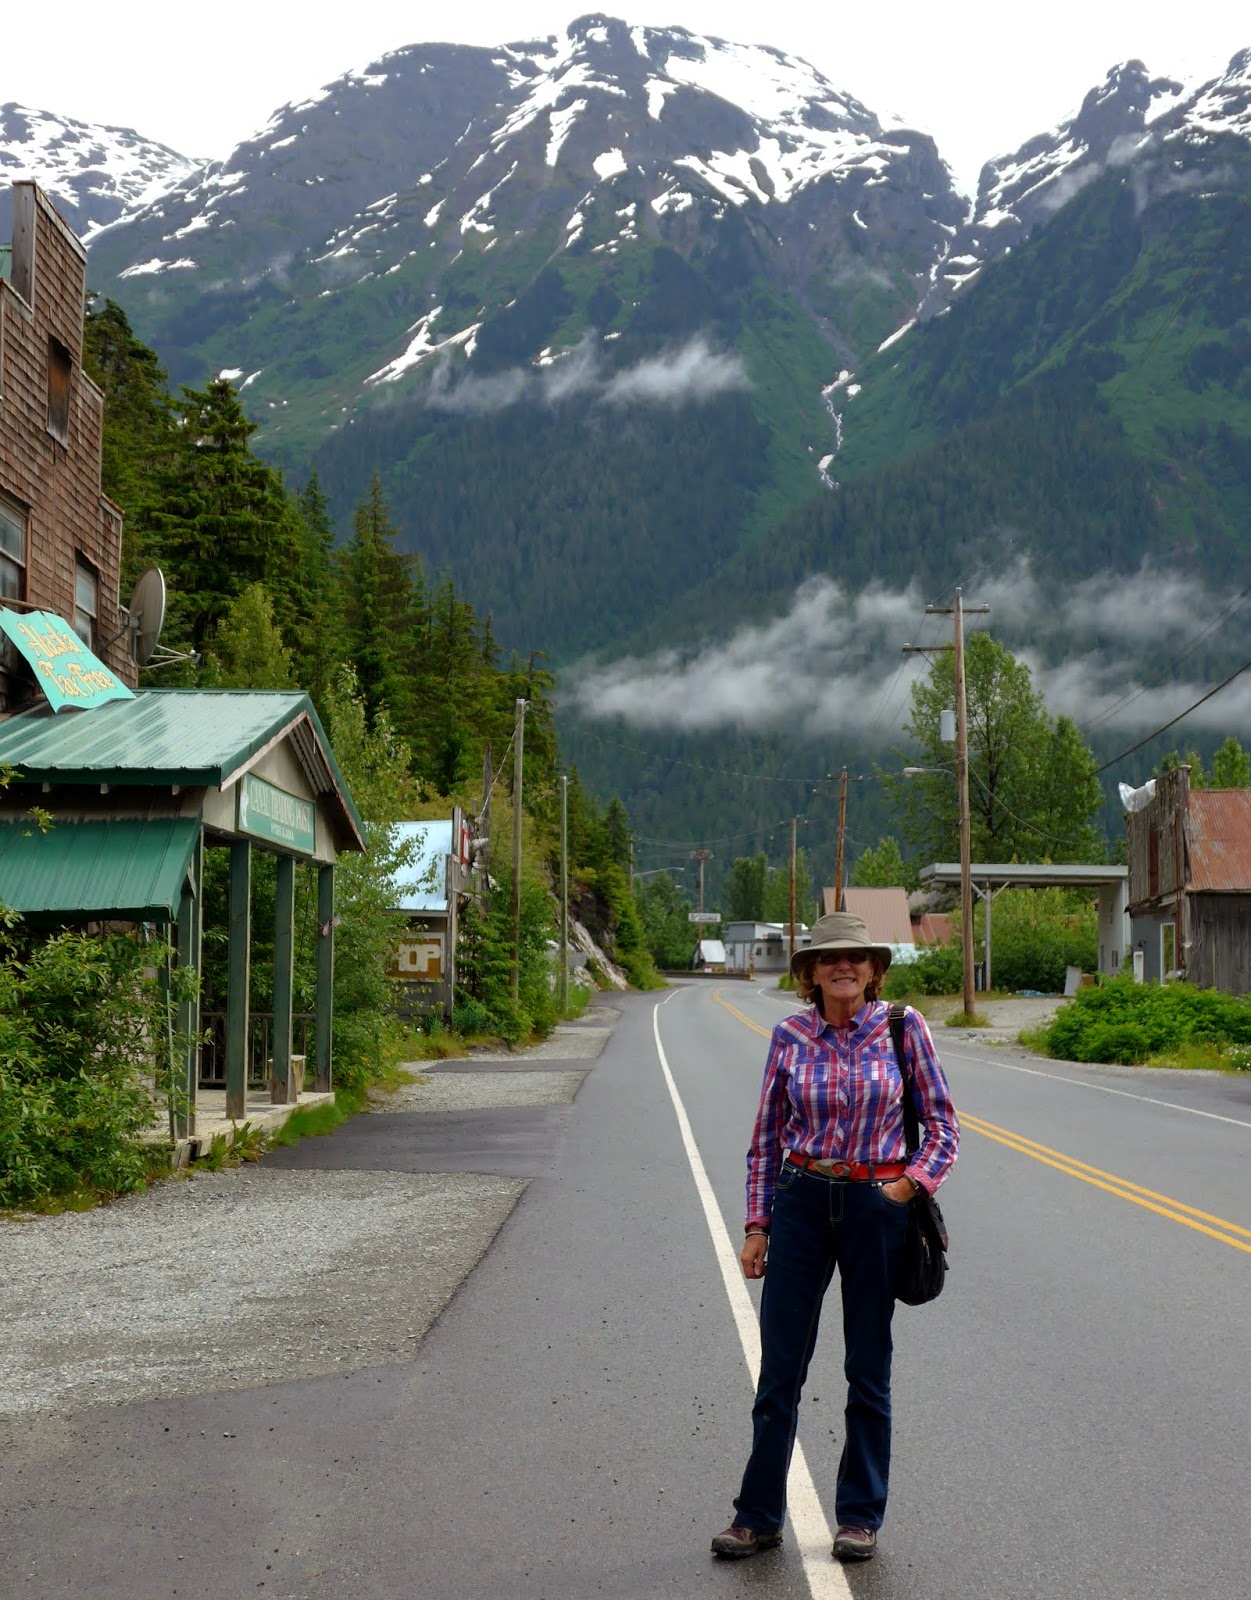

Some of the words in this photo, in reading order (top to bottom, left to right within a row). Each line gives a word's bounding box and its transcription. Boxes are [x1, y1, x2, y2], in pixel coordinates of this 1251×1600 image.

[17, 621, 83, 658] Alaska
[37, 659, 88, 698] Tax
[66, 662, 114, 696] Free
[296, 801, 311, 833] POST
